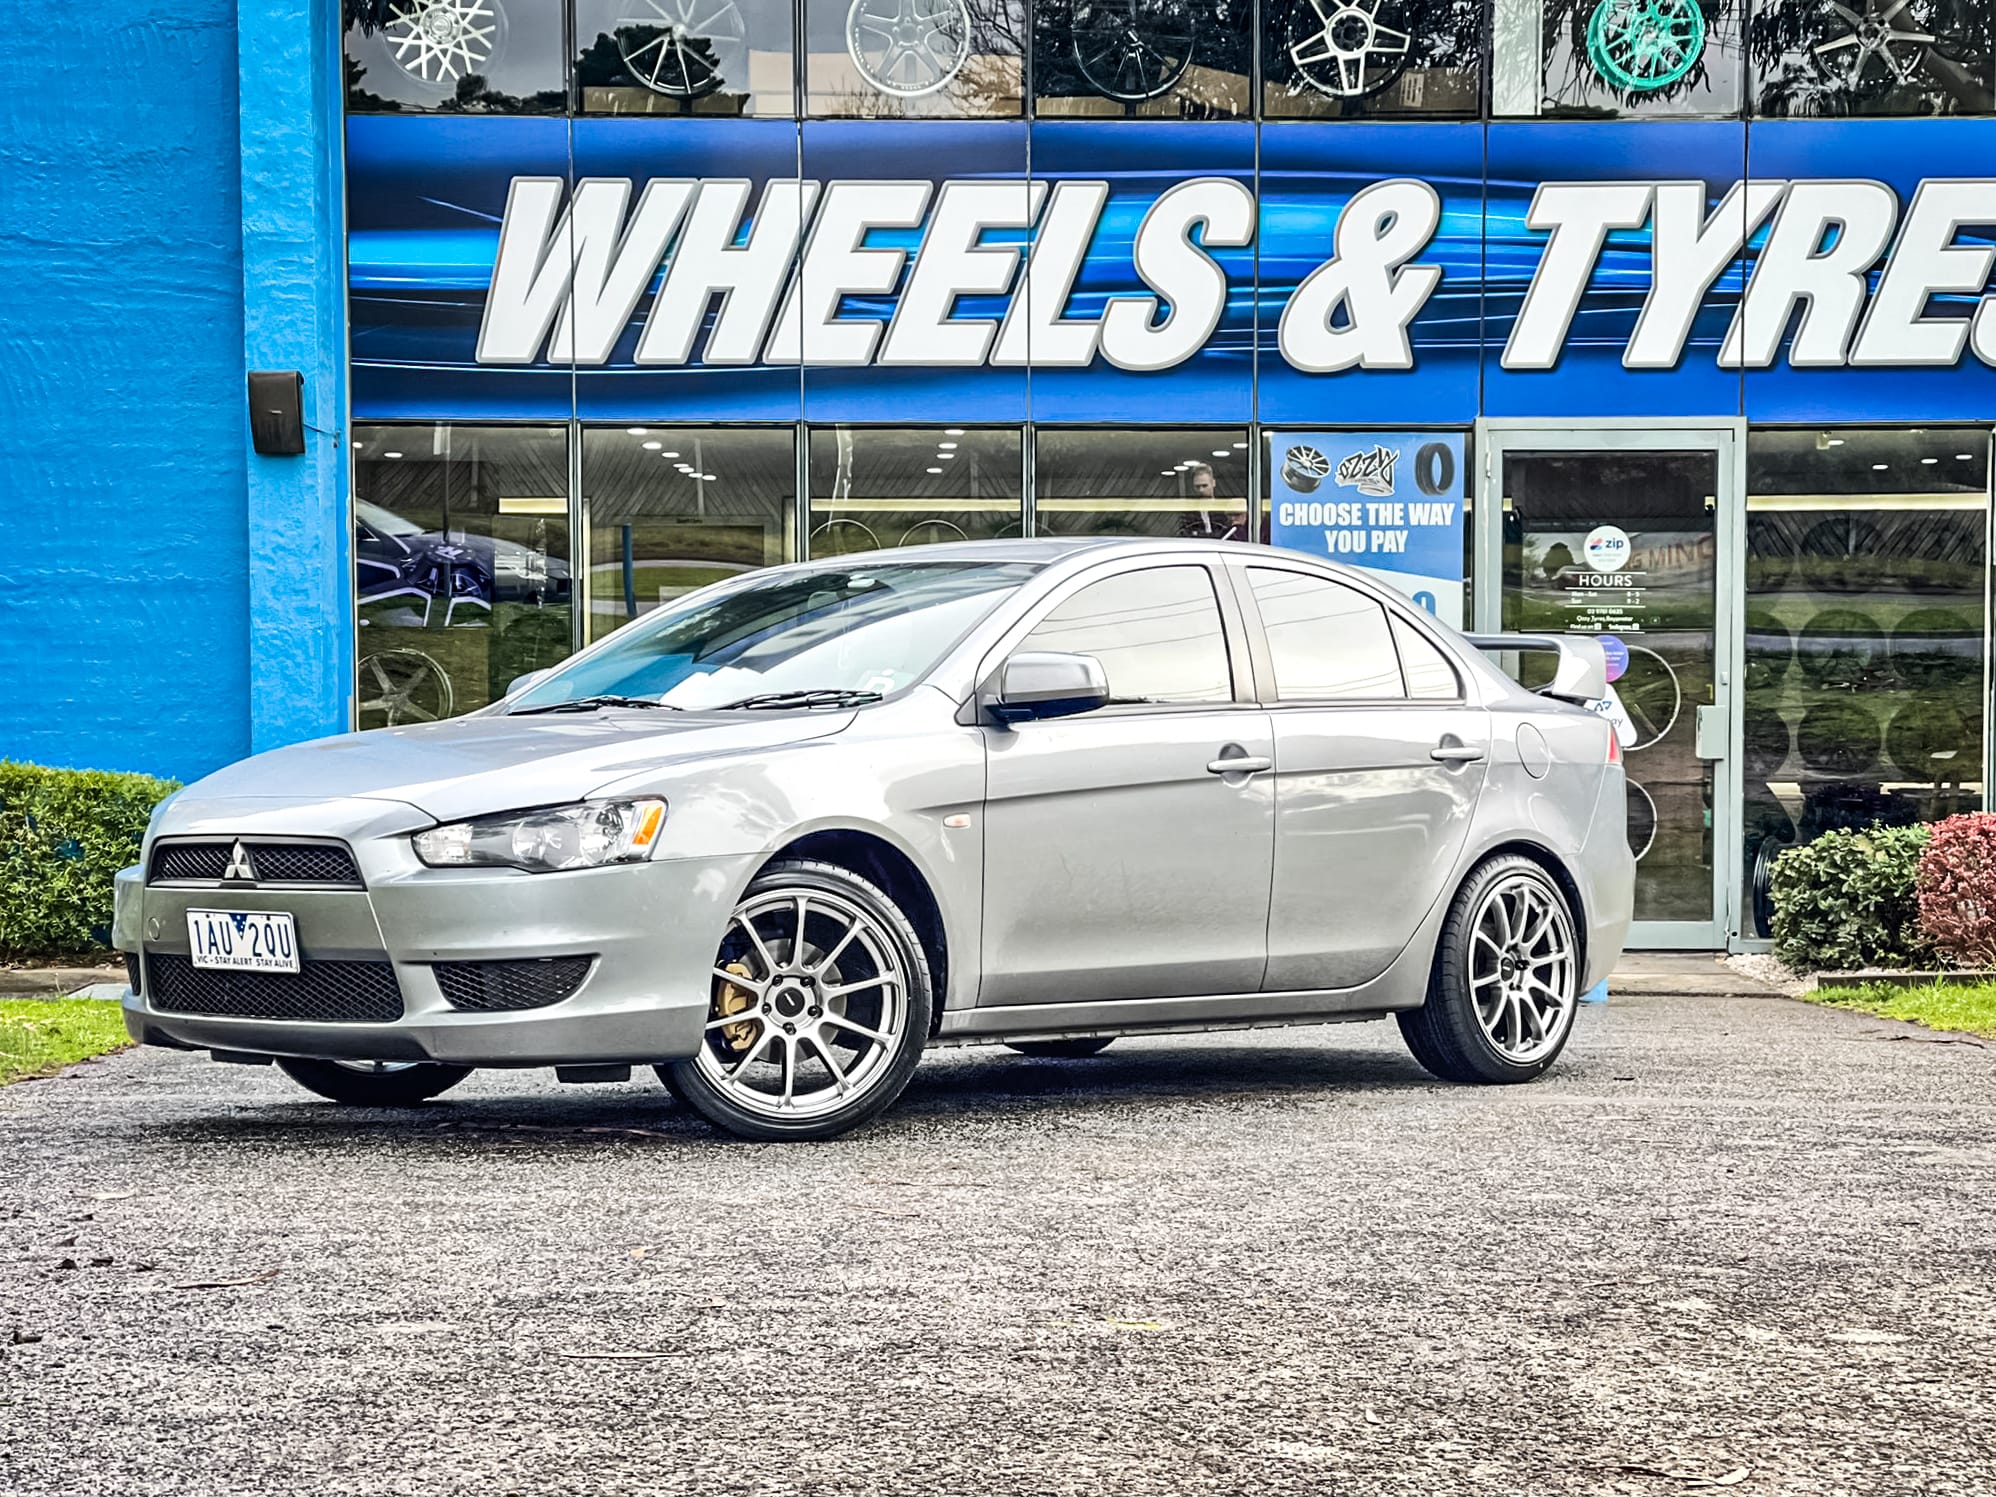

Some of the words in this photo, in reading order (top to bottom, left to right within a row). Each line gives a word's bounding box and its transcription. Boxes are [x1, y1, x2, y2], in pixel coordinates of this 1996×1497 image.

[476, 176, 1255, 371] WHEELS
[1277, 177, 1441, 373] &
[1279, 503, 1362, 526] CHOOSE
[1366, 503, 1404, 526] THE
[1408, 503, 1455, 526] WAY
[1325, 530, 1366, 553] YOU
[1371, 530, 1408, 553] PAY
[1605, 537, 1624, 549] zip
[1579, 575, 1633, 586] HOURS
[194, 920, 232, 955] 1AU
[248, 922, 291, 958] 2QU
[197, 955, 208, 963] VIC
[215, 956, 231, 964] STAY
[232, 957, 252, 966] ALERT
[256, 958, 272, 967] STAY
[274, 960, 293, 968] ALIVE
